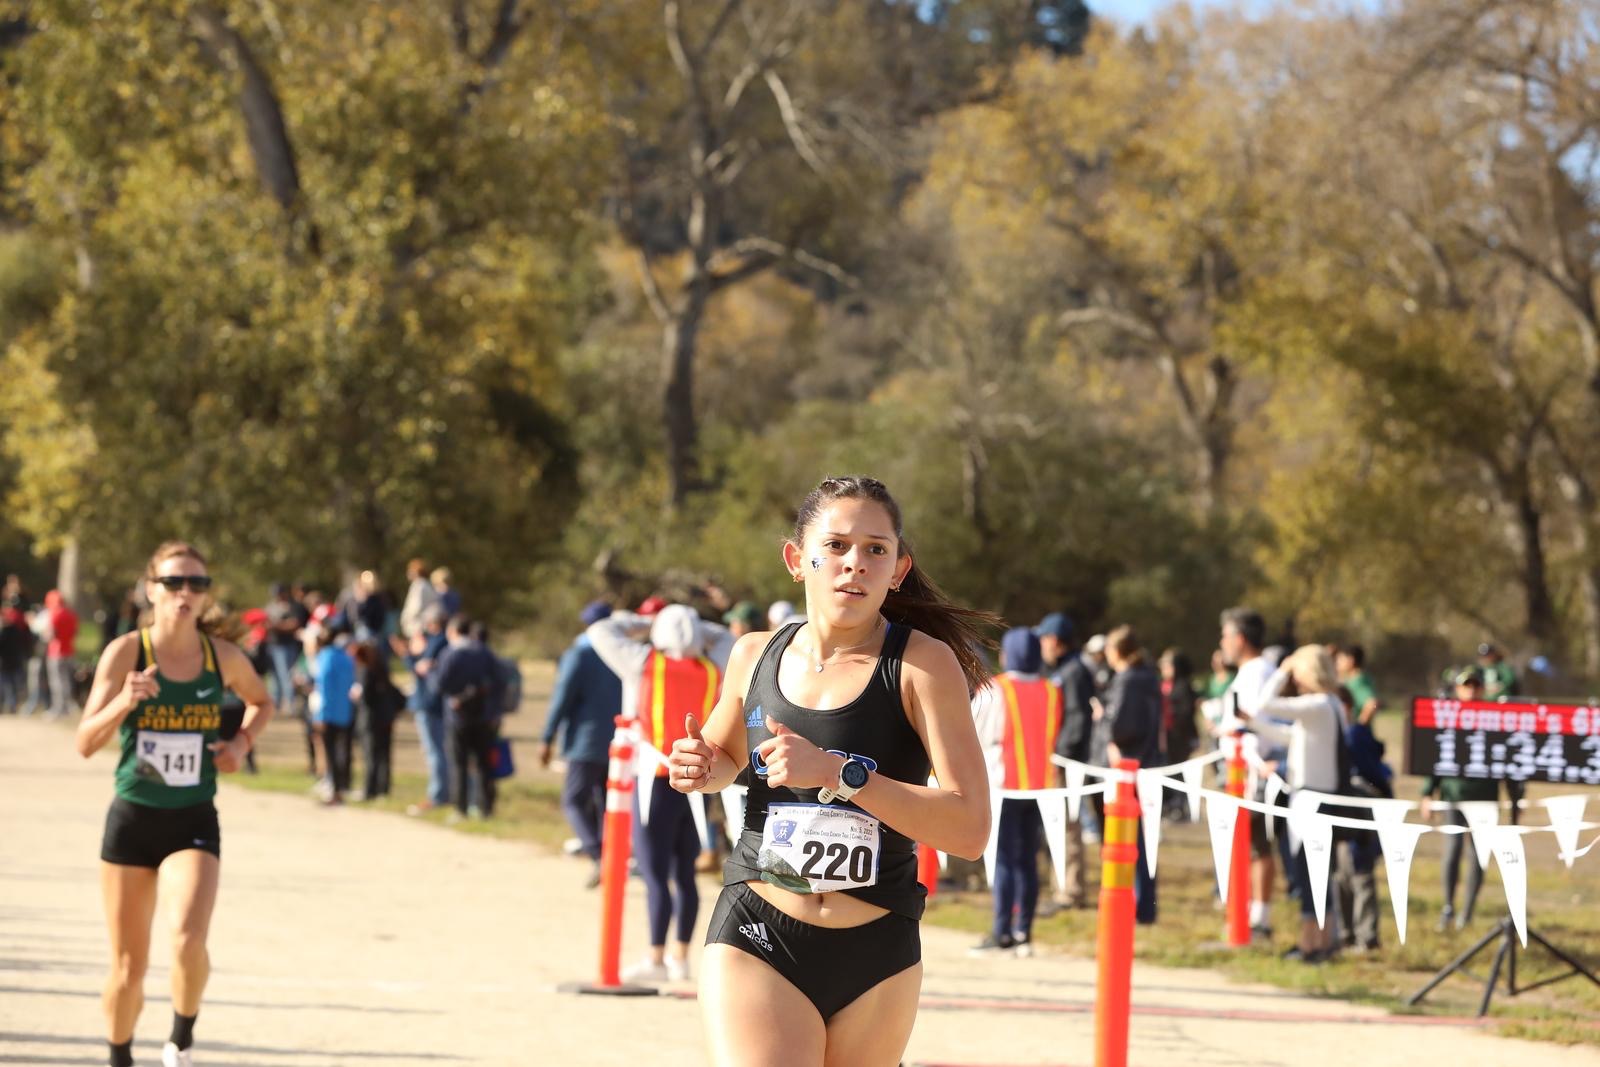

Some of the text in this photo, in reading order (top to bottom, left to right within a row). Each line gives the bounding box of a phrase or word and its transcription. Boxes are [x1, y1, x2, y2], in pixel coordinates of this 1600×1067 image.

[144, 705, 177, 716] CAL
[1433, 700, 1562, 732] Women's
[163, 753, 195, 773] 141
[800, 840, 873, 883] 220
[738, 925, 774, 952] adidas
